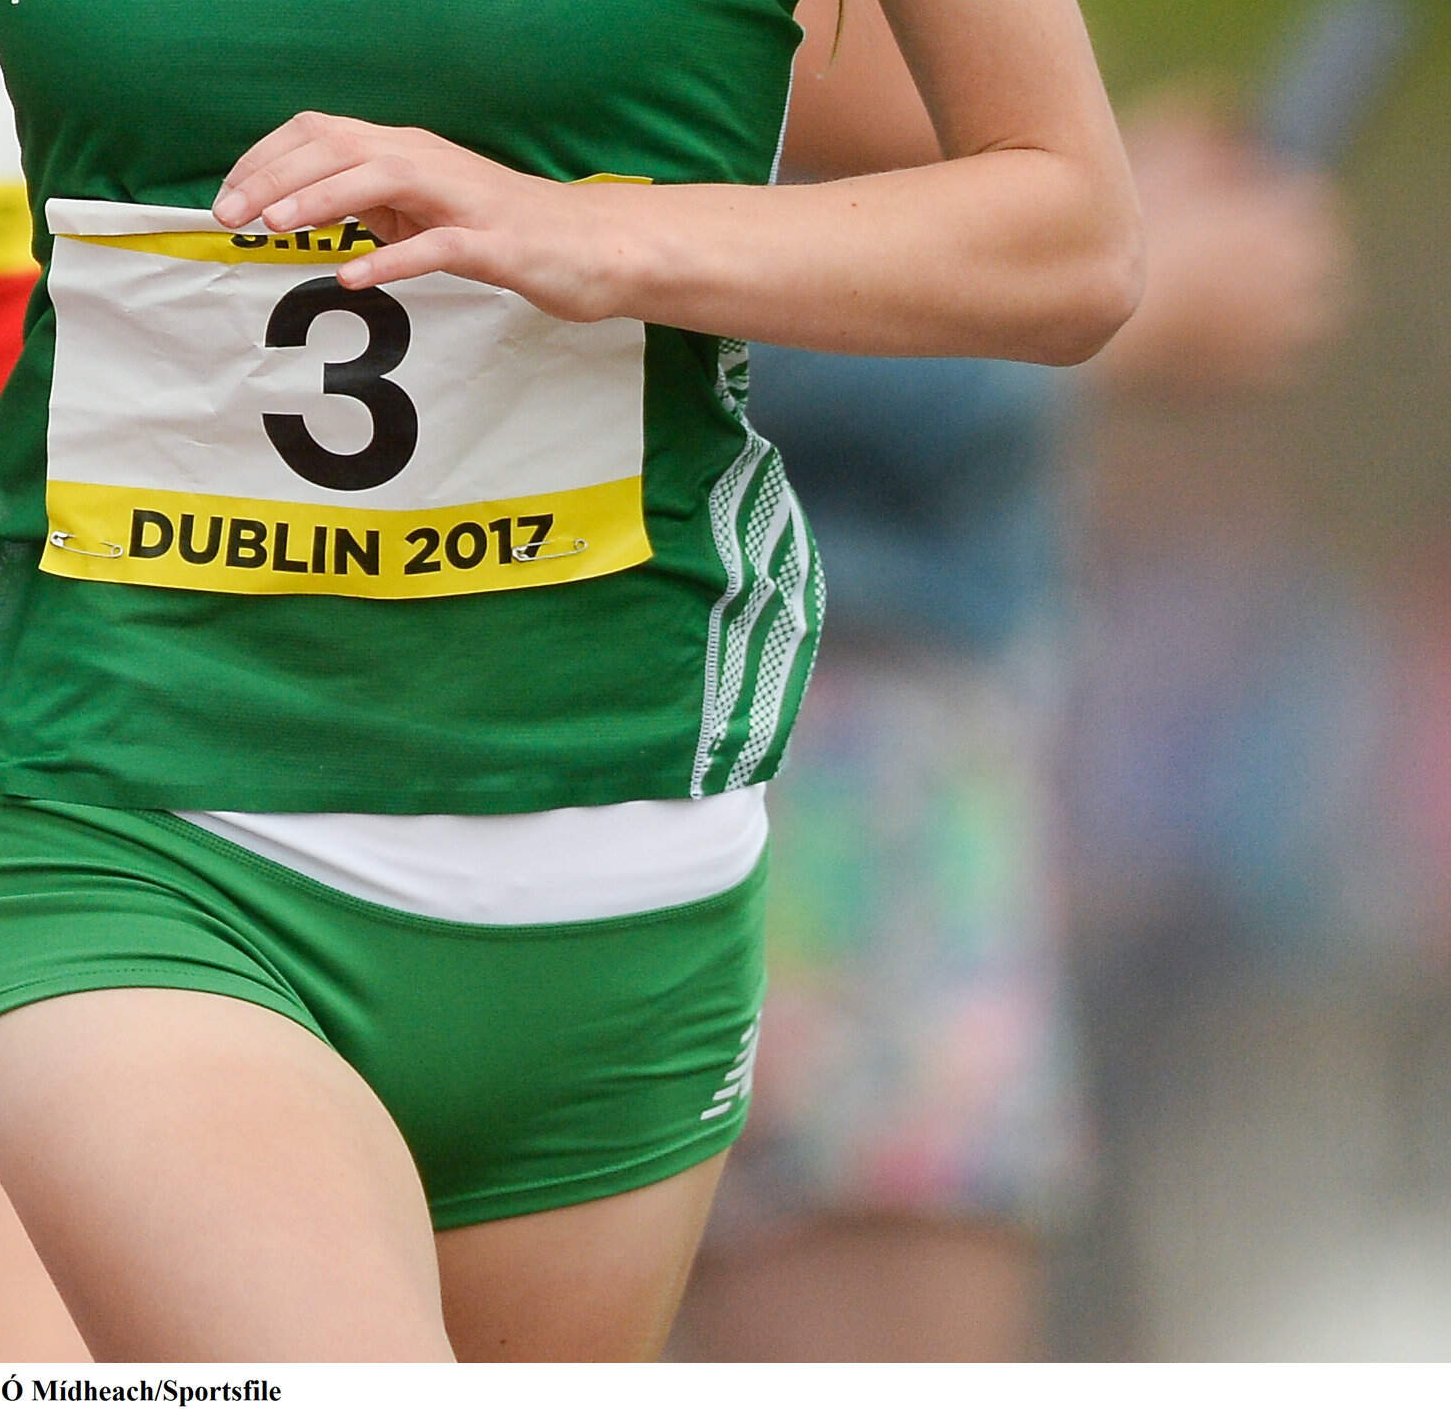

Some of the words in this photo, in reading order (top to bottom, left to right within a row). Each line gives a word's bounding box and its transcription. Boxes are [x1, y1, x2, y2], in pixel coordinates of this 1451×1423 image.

[260, 275, 420, 492] 3
[128, 508, 381, 577] DUBLIN
[403, 513, 556, 576] 2017
